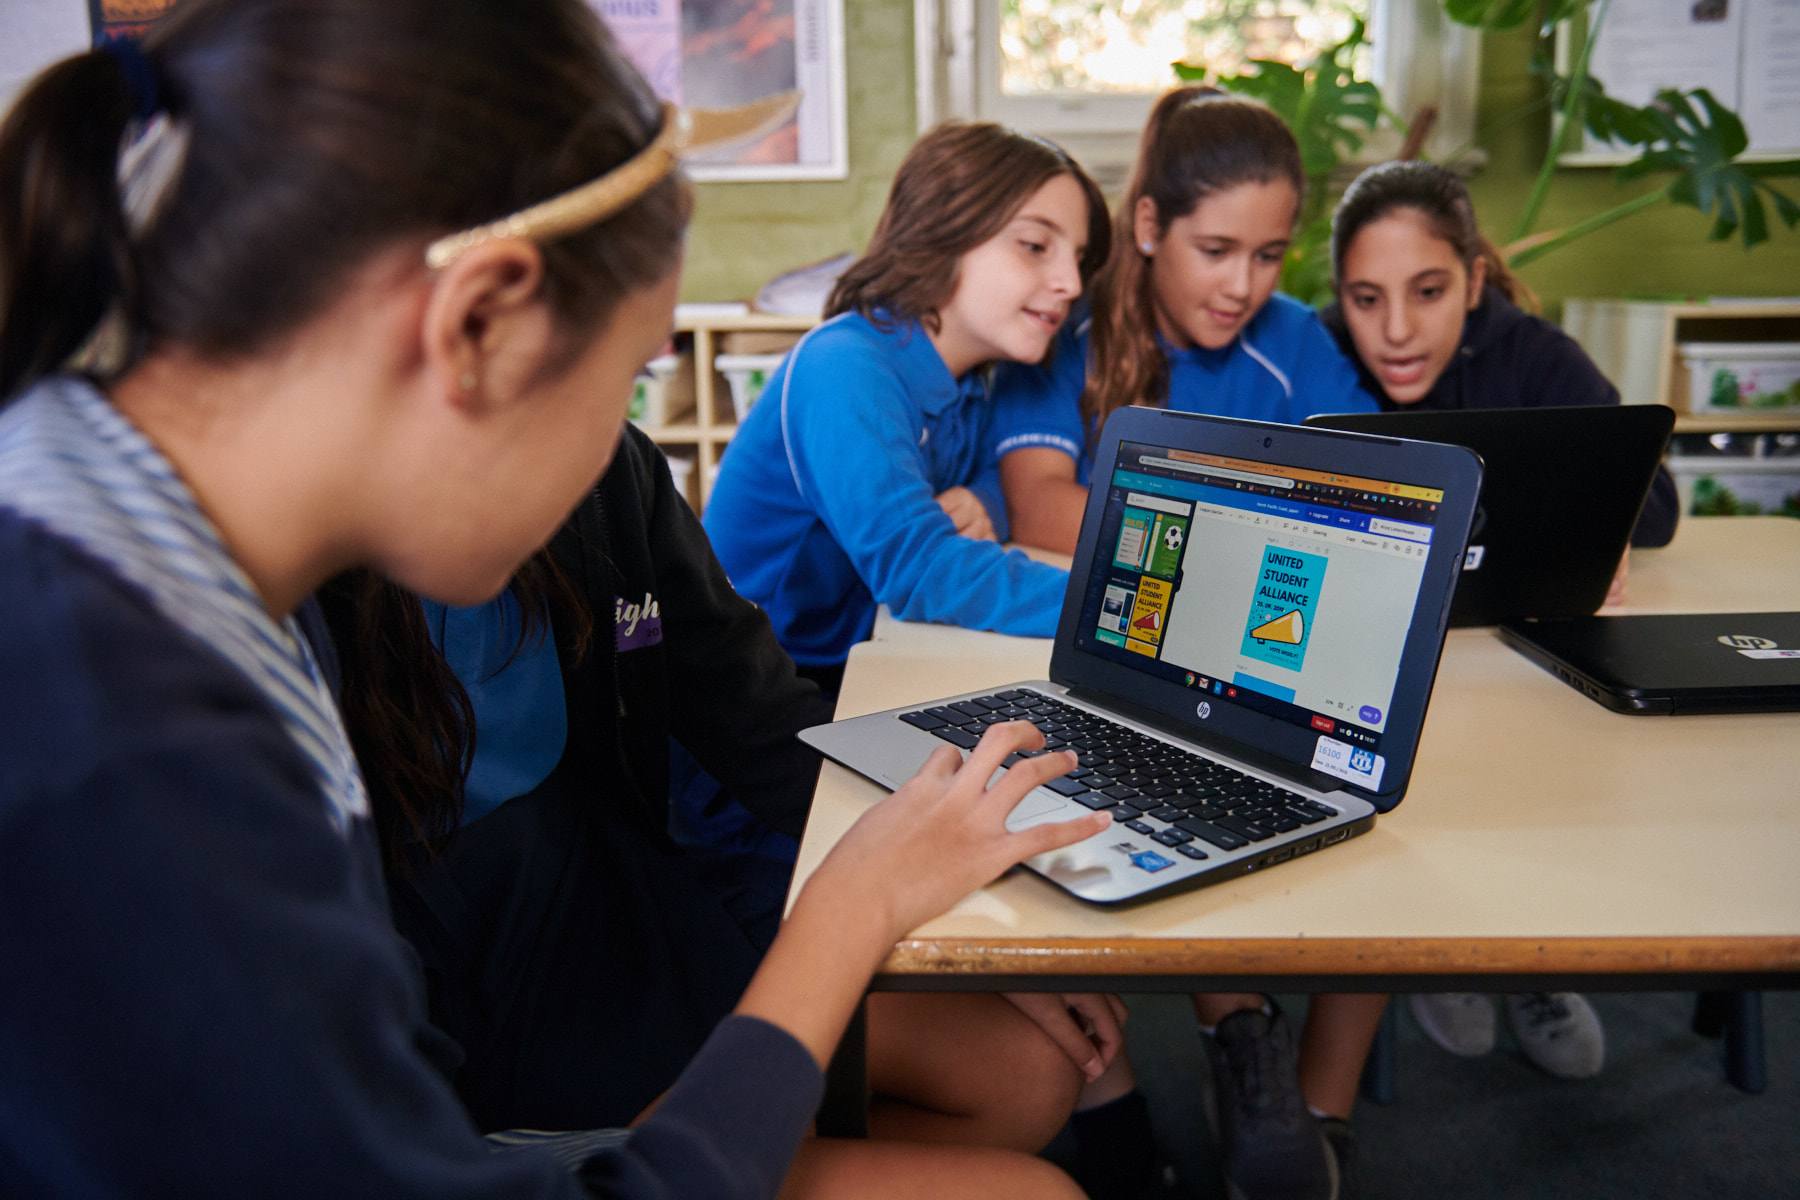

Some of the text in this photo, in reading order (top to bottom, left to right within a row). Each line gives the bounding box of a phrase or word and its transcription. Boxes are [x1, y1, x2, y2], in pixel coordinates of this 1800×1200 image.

[1268, 552, 1304, 570] UNITED
[1142, 580, 1161, 590] UNITED
[1263, 569, 1310, 588] STUDENT
[1140, 588, 1163, 600] STUDENT
[1259, 585, 1309, 607] ALLIANCE
[1138, 598, 1163, 610] ALLIANCE
[615, 592, 660, 637] igh
[1722, 634, 1773, 650] hp
[1197, 701, 1210, 719] hp
[1318, 745, 1341, 760] 16100
